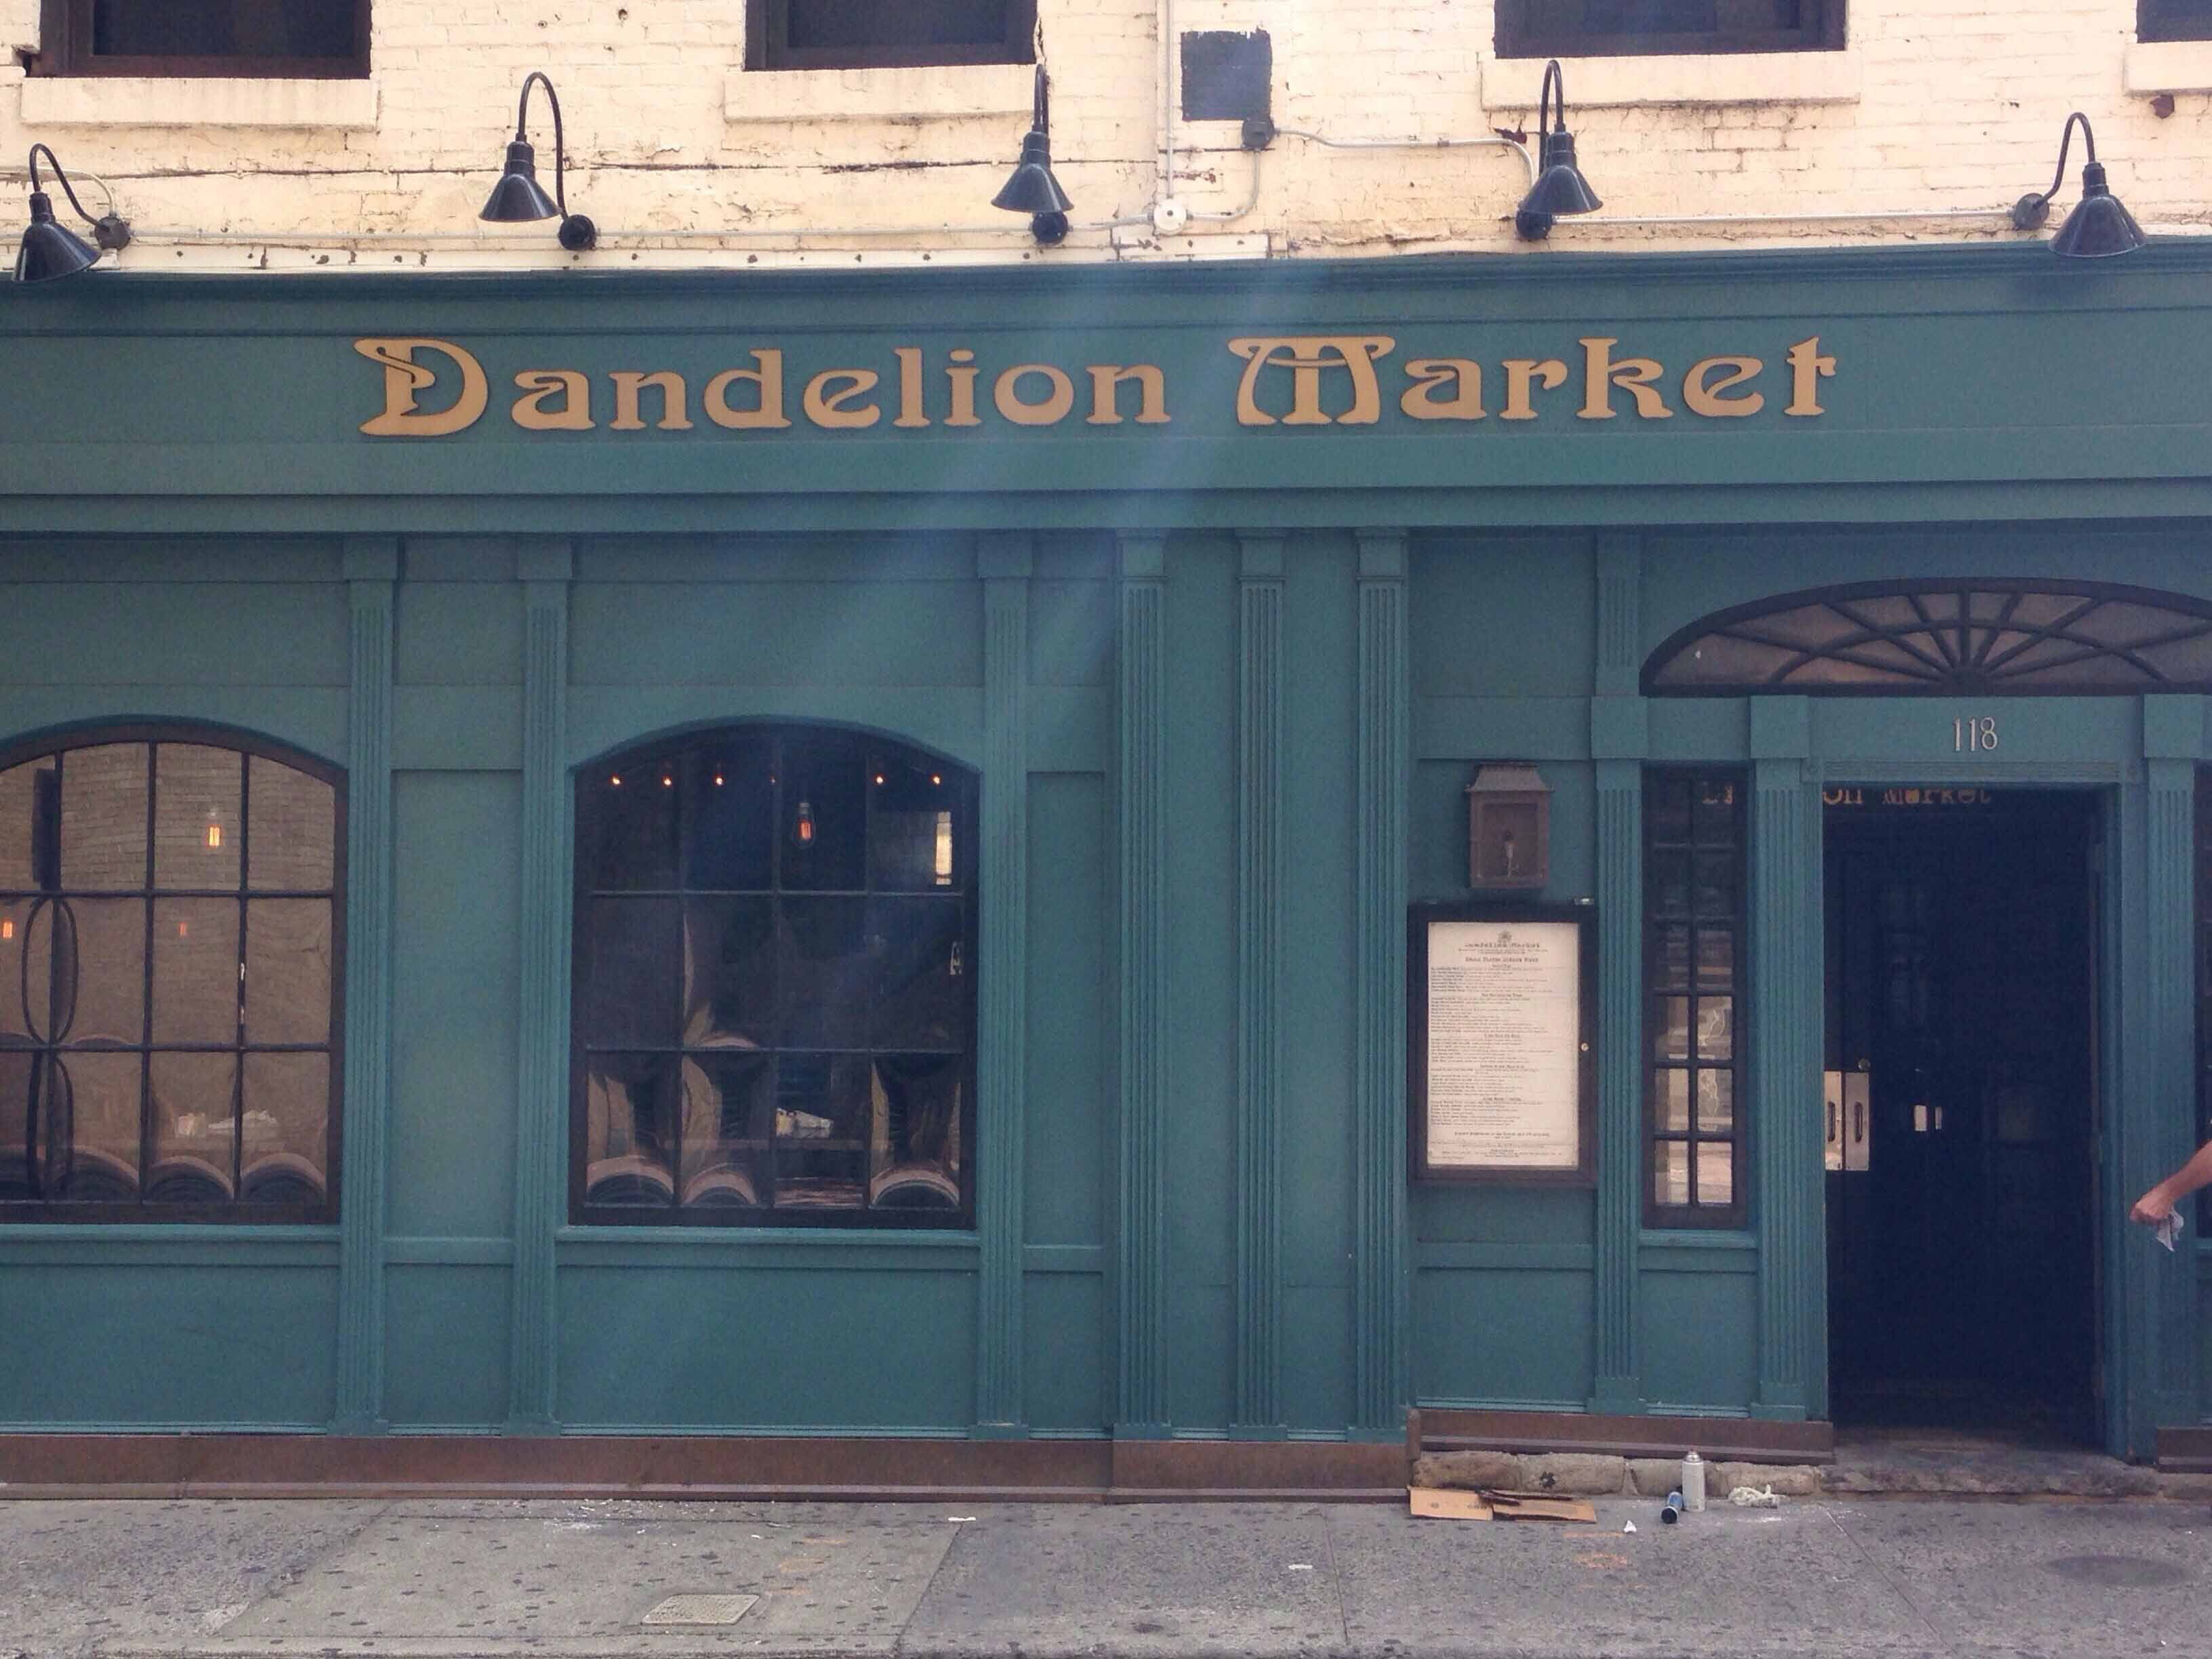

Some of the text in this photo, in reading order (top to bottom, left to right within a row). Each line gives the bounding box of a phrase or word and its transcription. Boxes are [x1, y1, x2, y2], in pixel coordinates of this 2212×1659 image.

[353, 334, 1838, 436] Dandelion Market
[1952, 716, 1999, 752] 118
